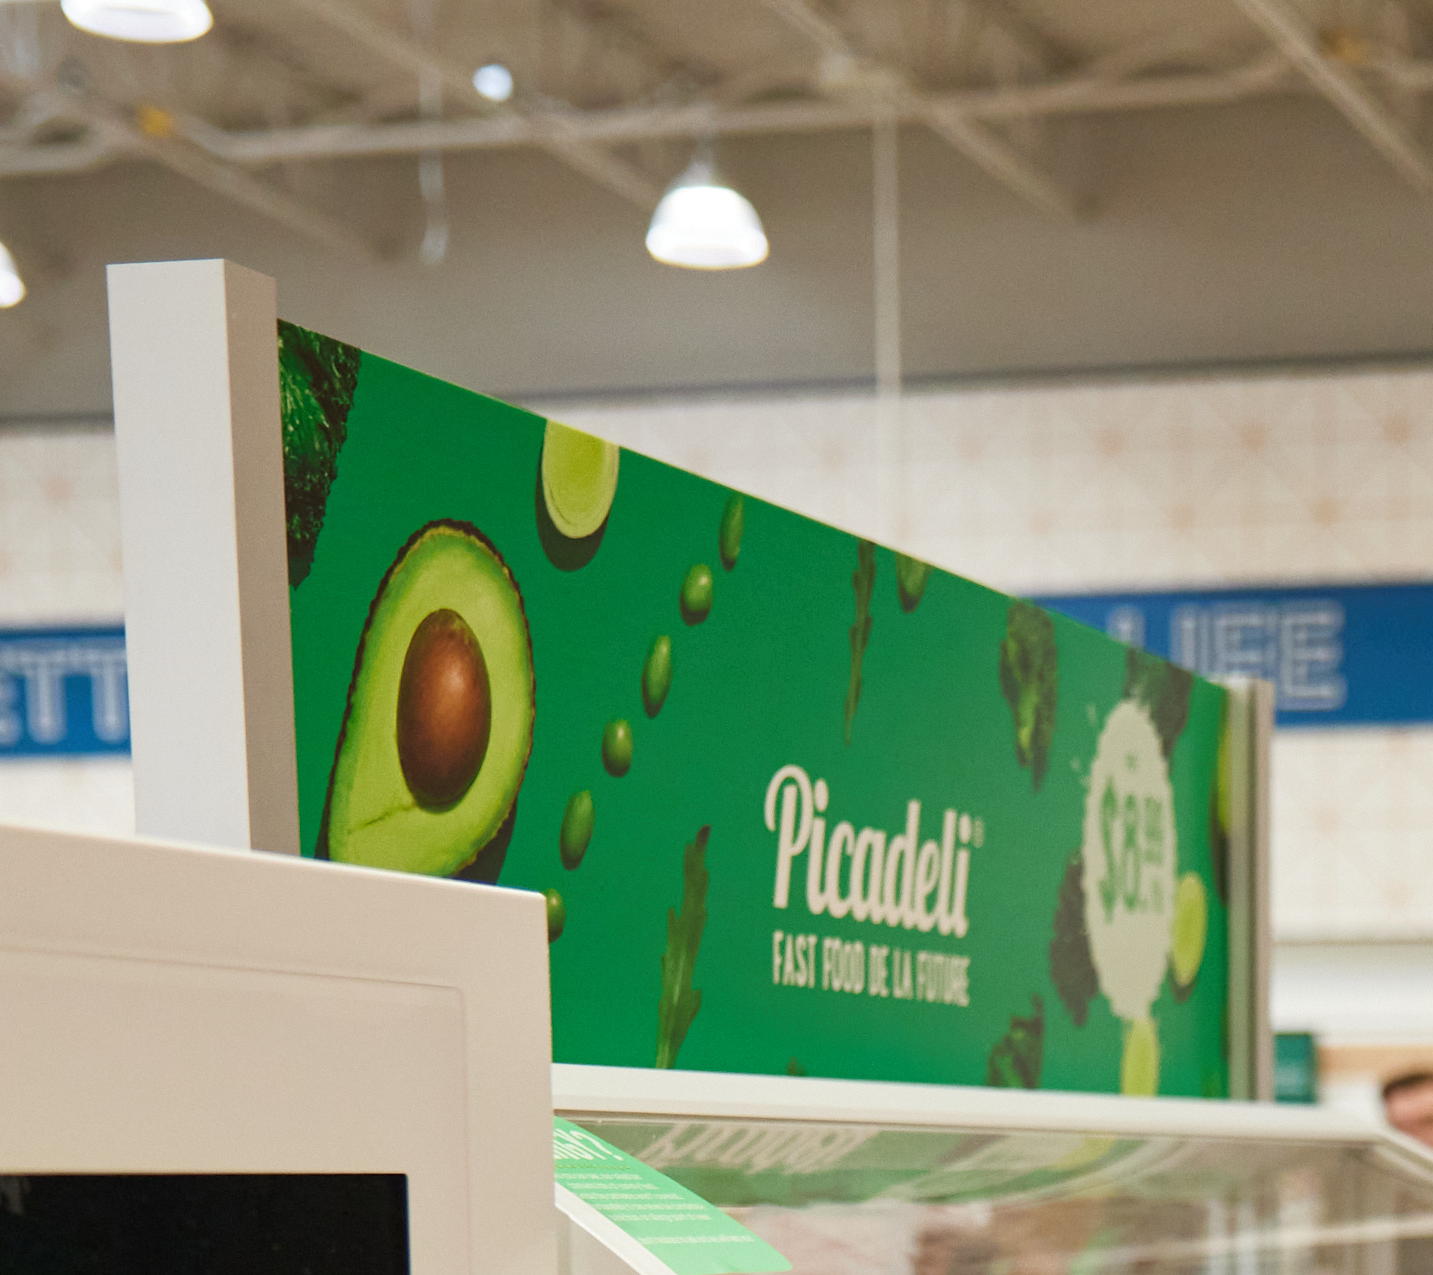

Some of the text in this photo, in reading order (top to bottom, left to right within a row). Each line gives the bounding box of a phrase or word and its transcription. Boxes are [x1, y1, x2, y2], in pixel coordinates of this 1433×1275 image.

[1104, 598, 1346, 713] IFE
[763, 763, 972, 939] Picadeli
[771, 930, 972, 1008] FAST FOOD DE LA FUTURE
